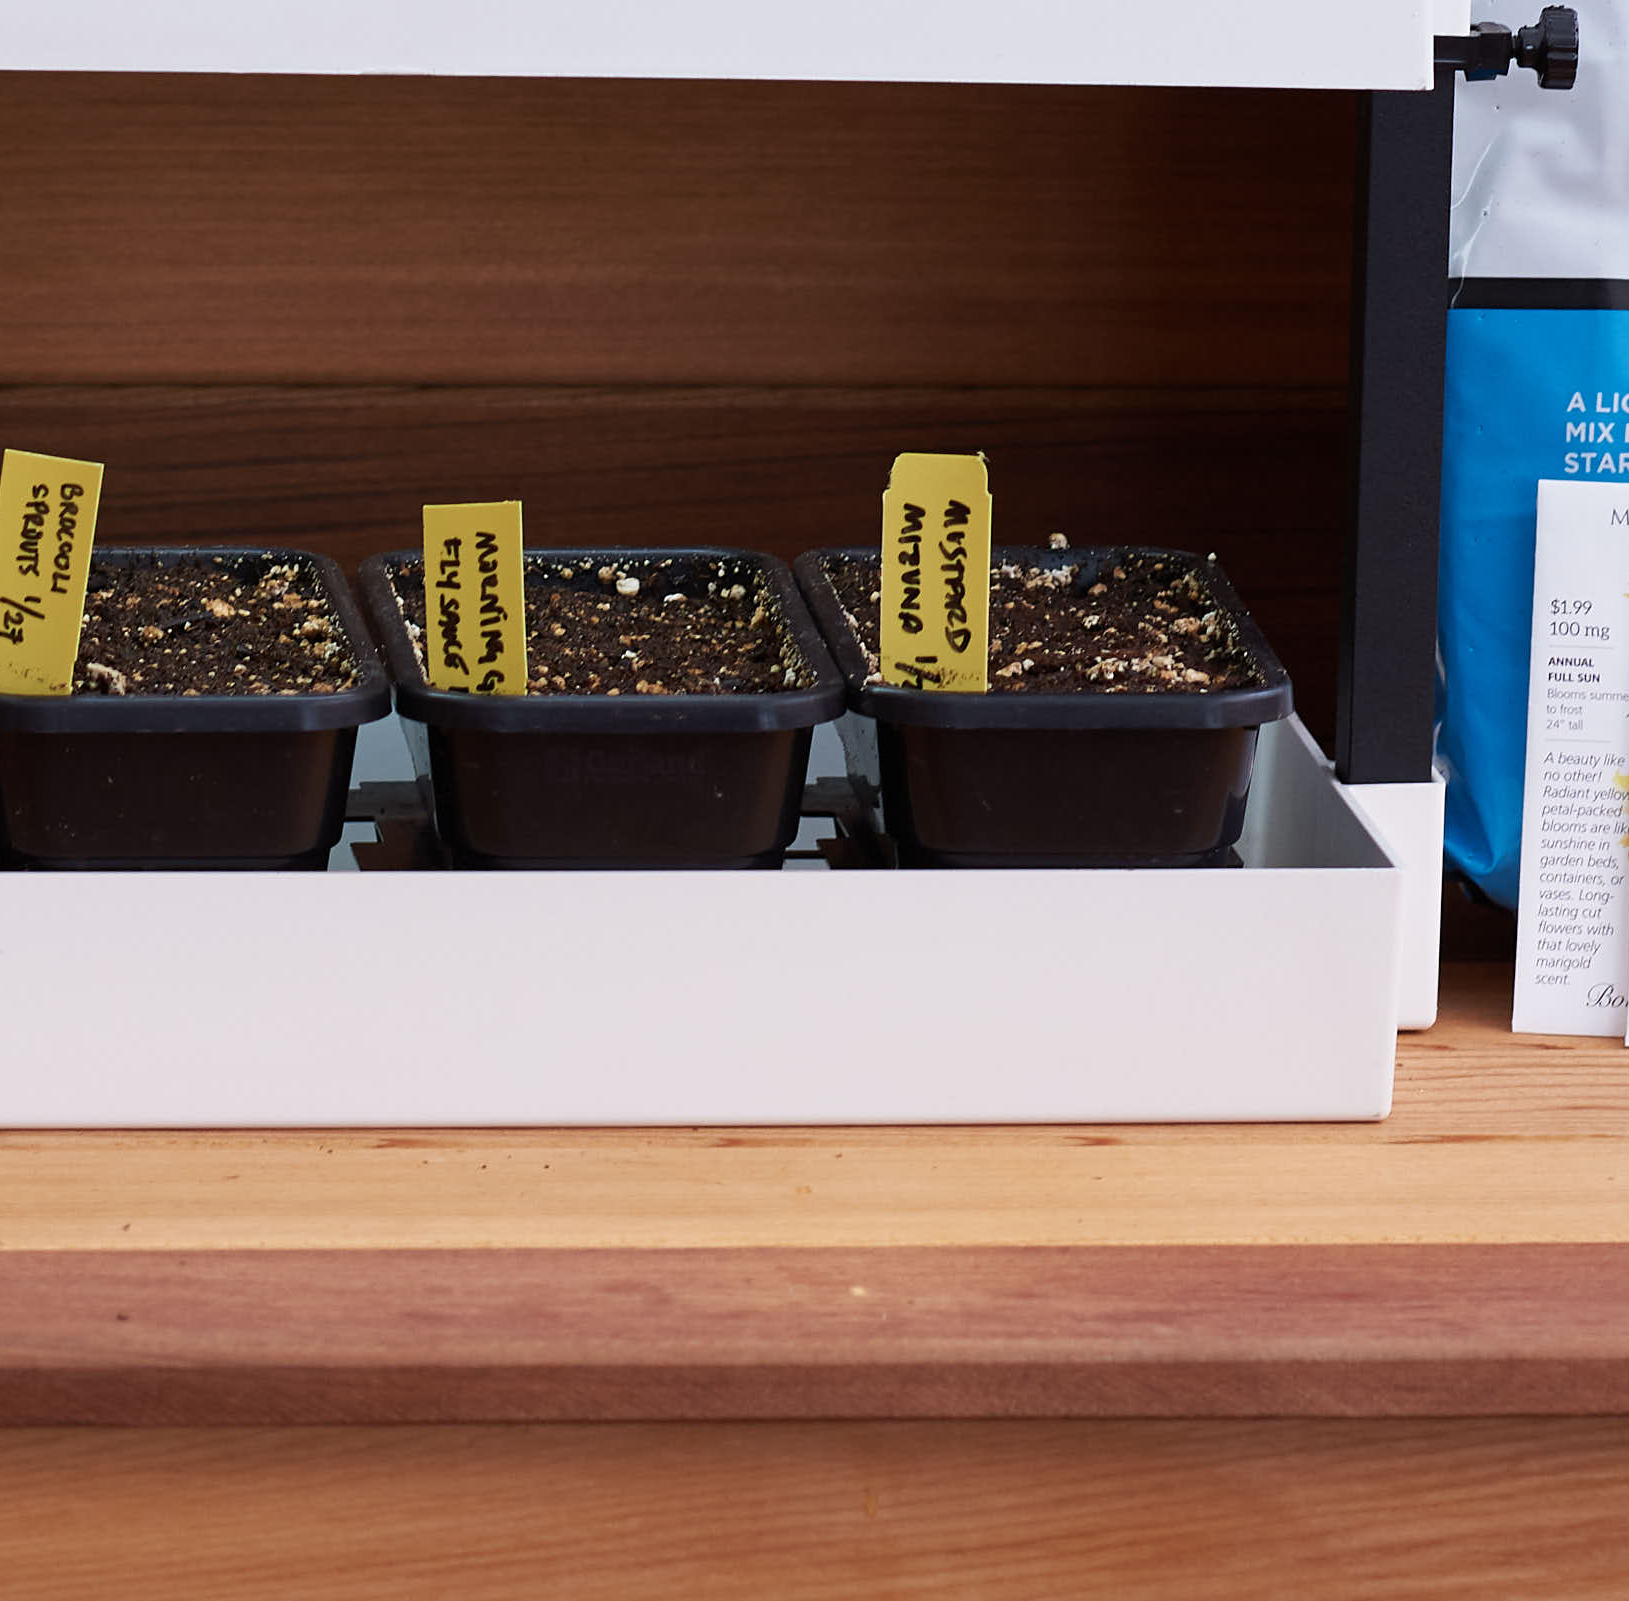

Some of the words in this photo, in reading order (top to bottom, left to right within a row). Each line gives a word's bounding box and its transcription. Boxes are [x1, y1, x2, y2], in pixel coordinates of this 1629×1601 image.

[1566, 391, 1589, 414] A
[1565, 422, 1615, 445] MIX
[16, 483, 50, 577] SPROUTS
[1550, 599, 1593, 616] $1.99
[1549, 620, 1580, 637] 100
[1584, 624, 1611, 641] mg
[1548, 655, 1595, 668] ANNUAL
[1548, 672, 1574, 683] FULL
[1577, 672, 1601, 683] SUN
